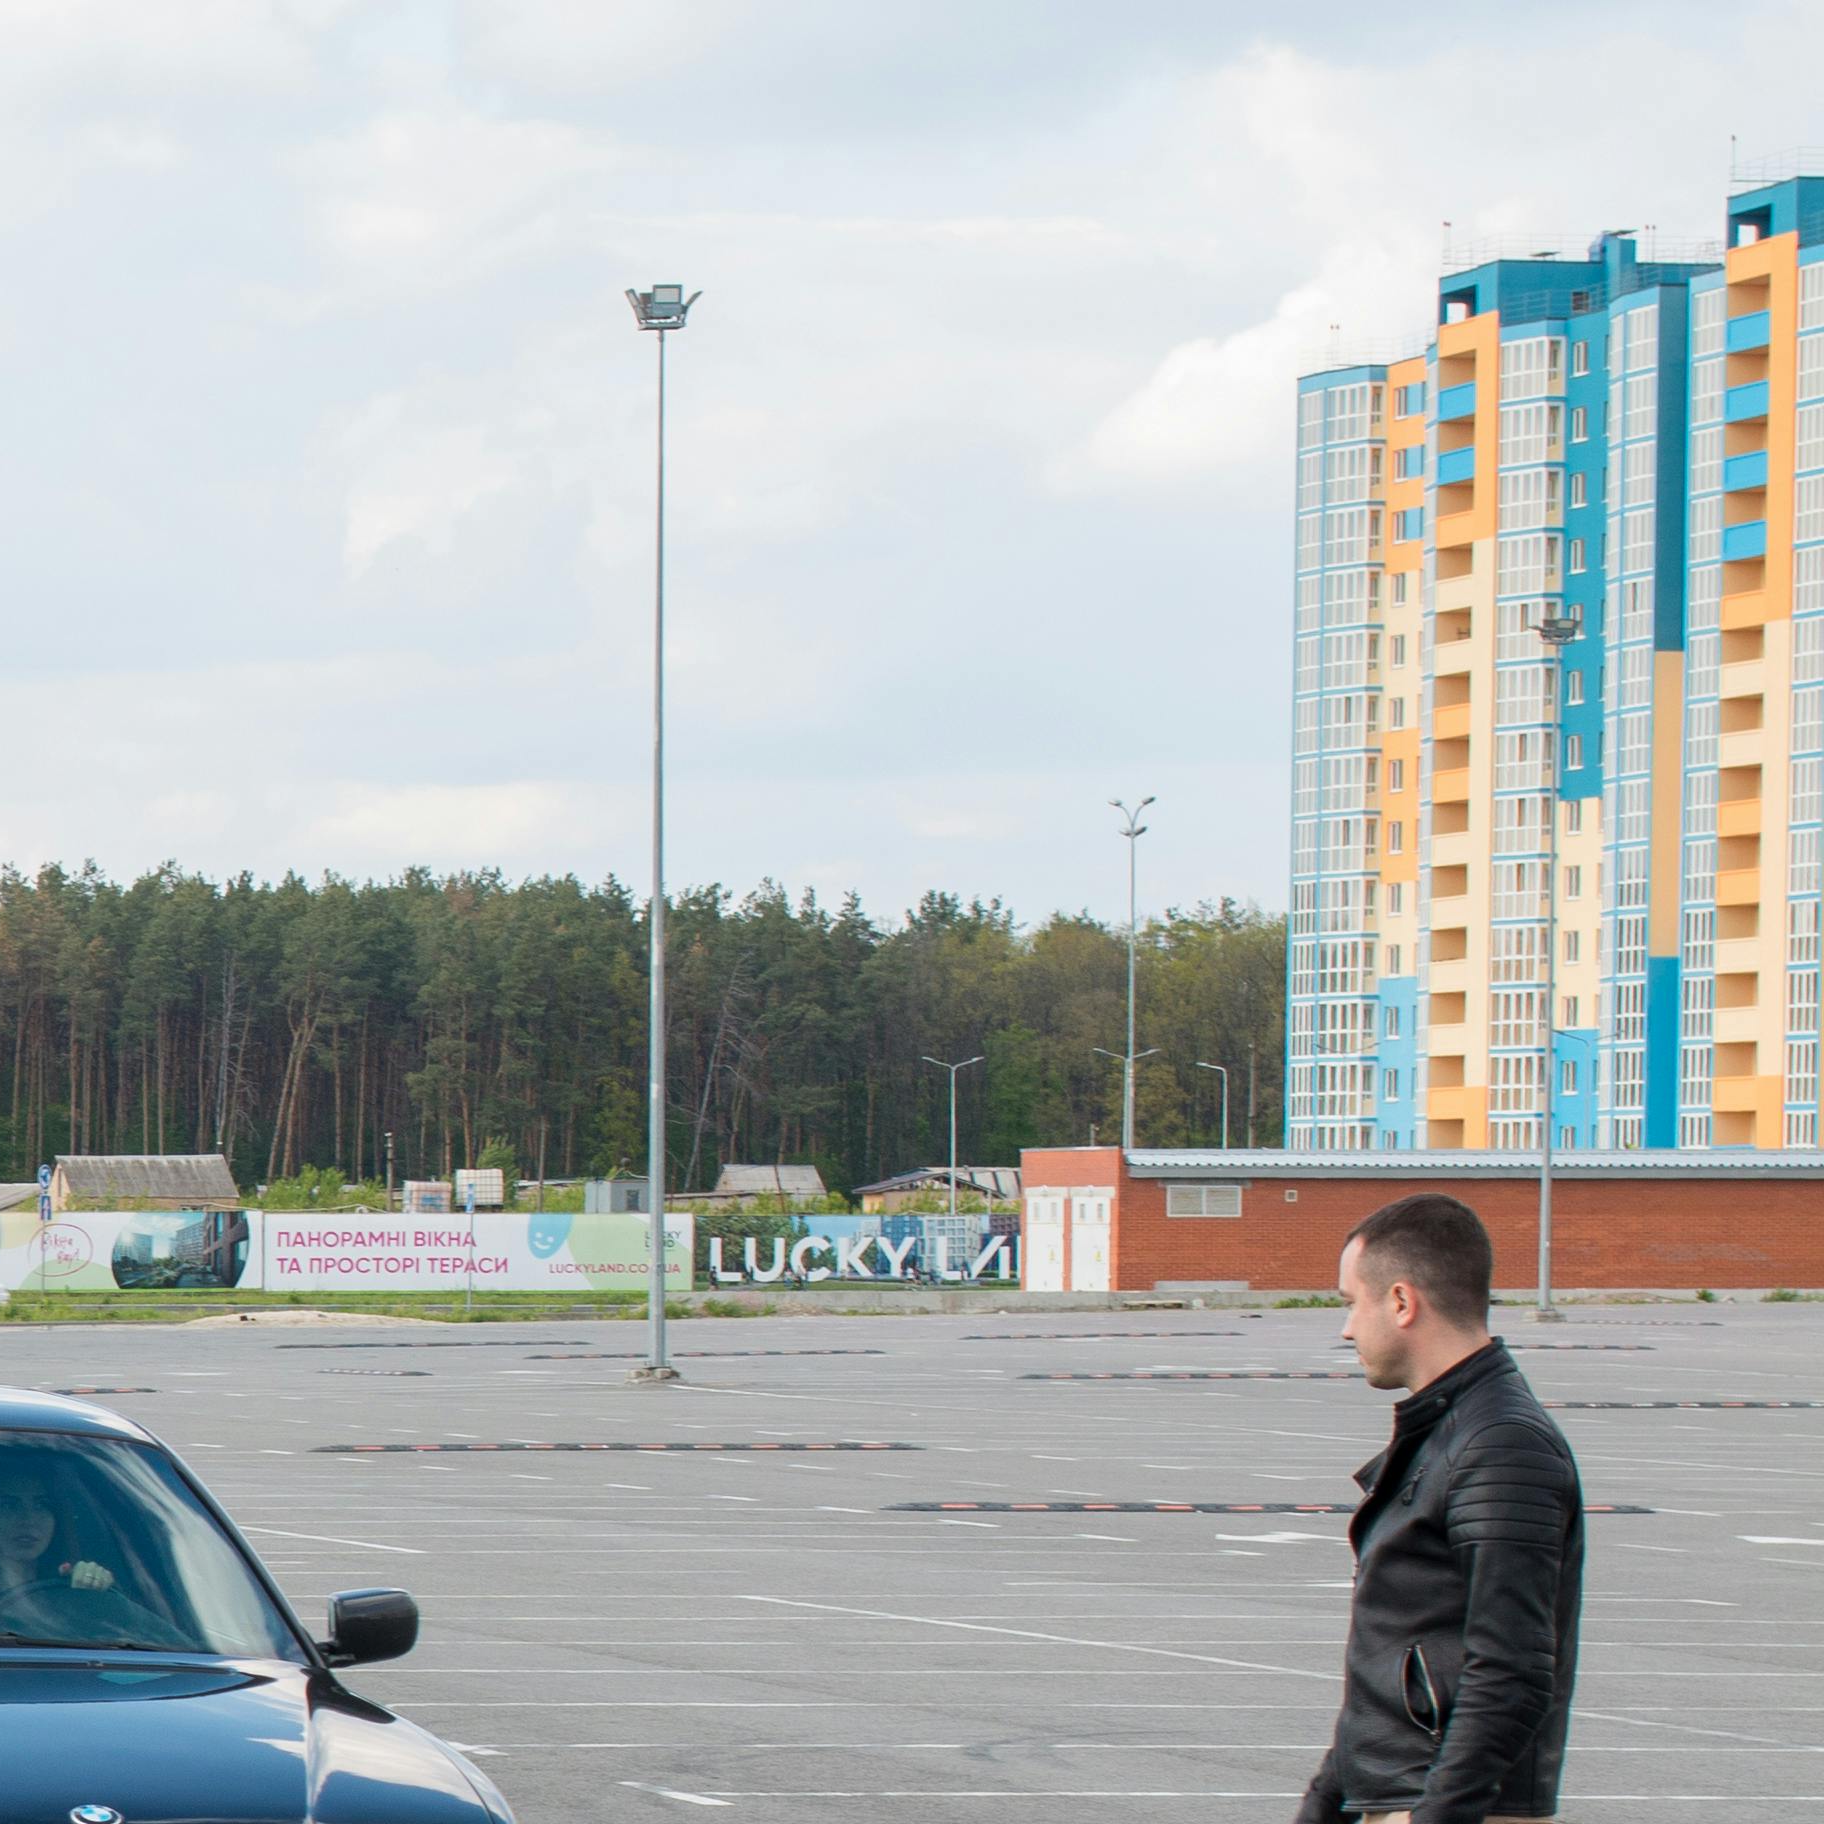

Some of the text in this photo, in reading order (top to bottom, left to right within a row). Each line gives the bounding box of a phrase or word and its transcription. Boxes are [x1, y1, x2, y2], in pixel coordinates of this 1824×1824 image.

[277, 1231, 477, 1247] ПАНОРАМНІ ВІКНА
[276, 1258, 509, 1273] ТА ПРОСТОРІ ТЕРАСИ
[710, 1235, 916, 1282] LUCKY
[549, 1263, 681, 1273] LUCKYLAND.COUA
